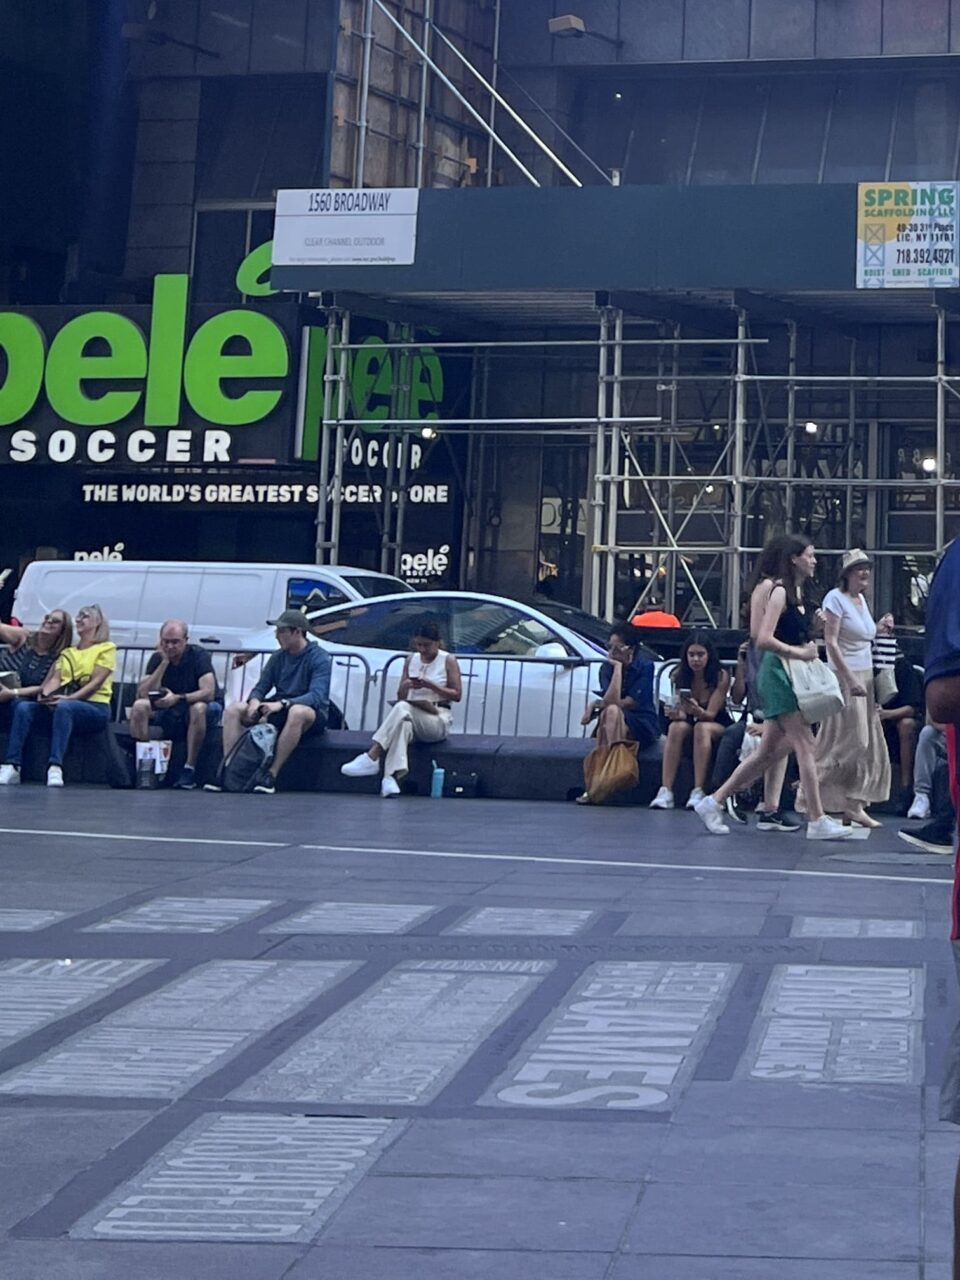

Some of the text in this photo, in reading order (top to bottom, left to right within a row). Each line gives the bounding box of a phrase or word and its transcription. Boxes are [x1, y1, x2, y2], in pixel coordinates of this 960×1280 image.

[308, 192, 391, 212] 1560 BROADWAY
[864, 188, 954, 206] SPRING
[864, 207, 955, 217] SCAFFOLDING LLC
[916, 233, 927, 242] NY
[9, 429, 231, 462] SOCCER
[83, 485, 448, 503] THE WORLD'S GREATEST SCER ORE
[401, 545, 450, 576] pelé
